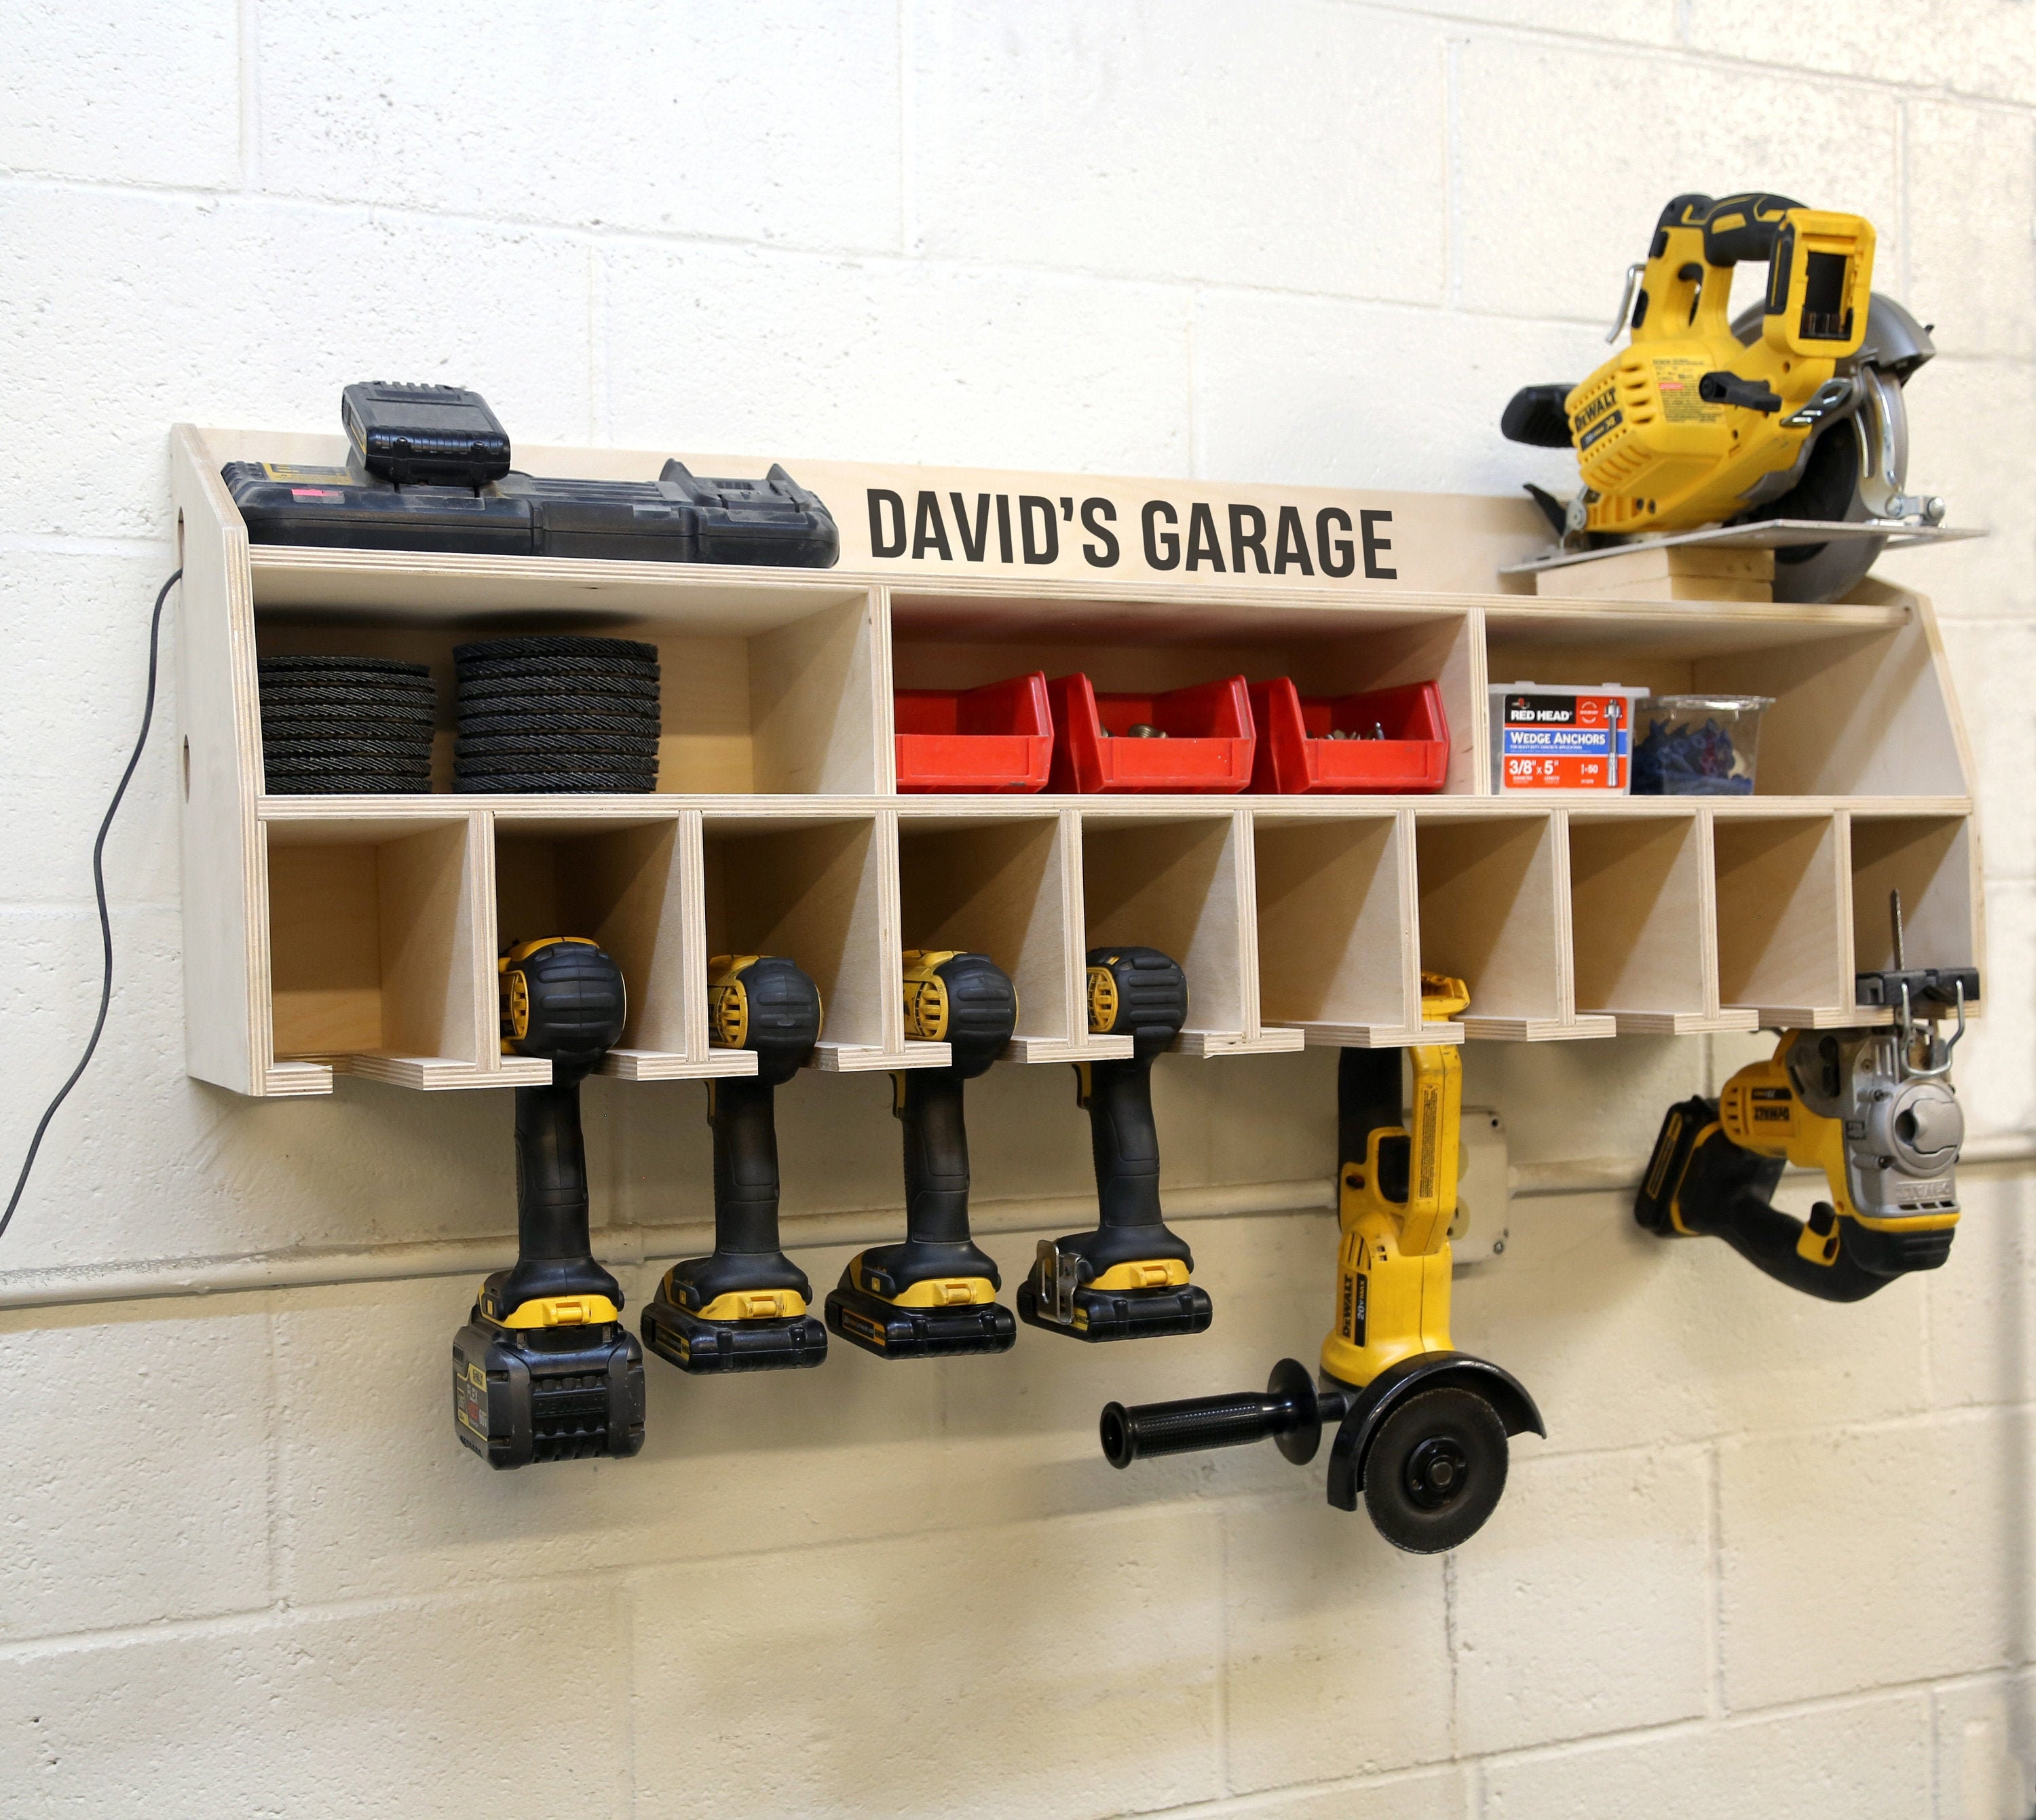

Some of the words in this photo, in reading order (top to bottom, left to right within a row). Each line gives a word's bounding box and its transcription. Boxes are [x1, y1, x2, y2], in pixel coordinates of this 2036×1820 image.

[867, 488, 1120, 569] DAVID'S
[1141, 500, 1398, 580] GARAGE
[1511, 710, 1535, 721] RED
[1537, 710, 1570, 721] HEAD
[1511, 732, 1551, 744] WEDGE
[1554, 732, 1606, 745] ANCHORS
[1509, 759, 1537, 775] 3/8"
[1544, 759, 1560, 775] 5"
